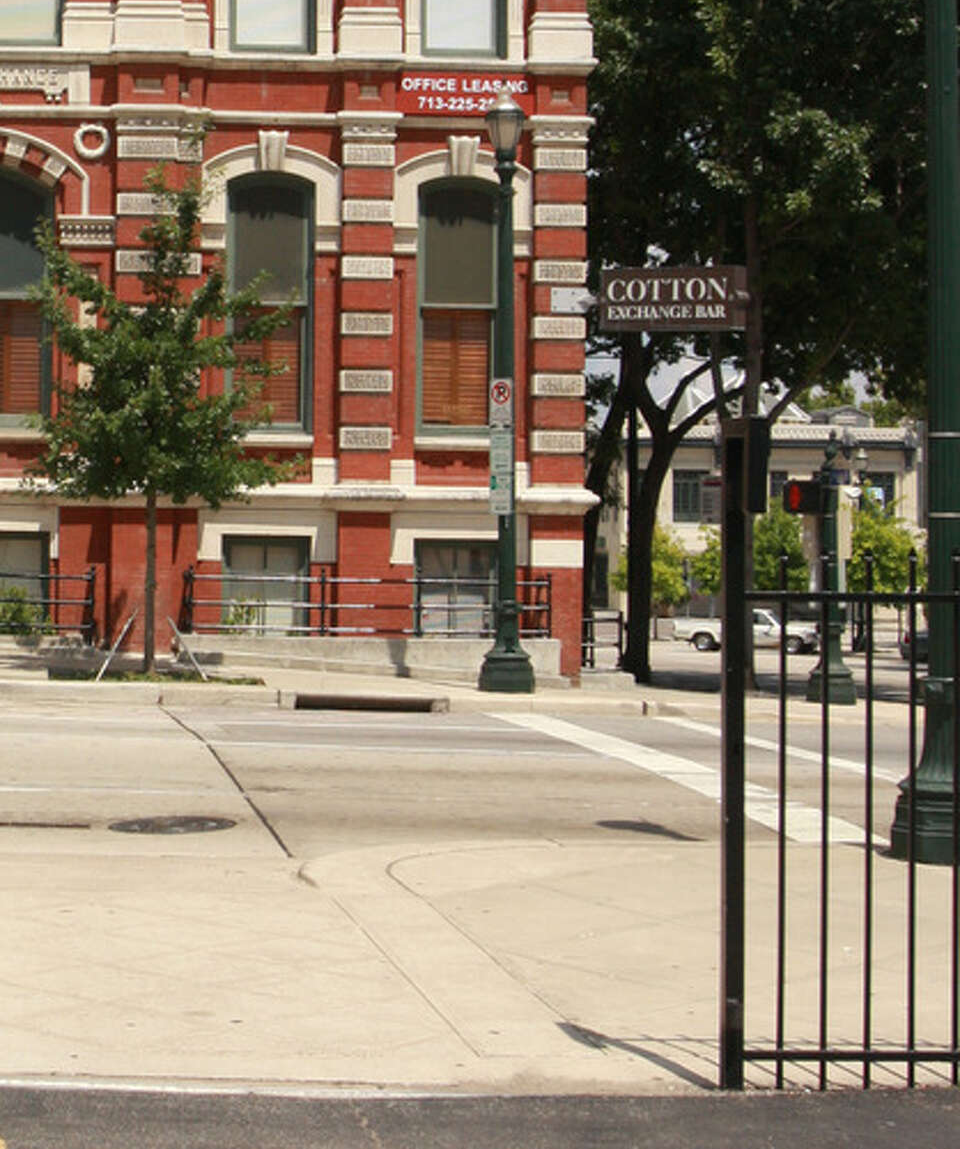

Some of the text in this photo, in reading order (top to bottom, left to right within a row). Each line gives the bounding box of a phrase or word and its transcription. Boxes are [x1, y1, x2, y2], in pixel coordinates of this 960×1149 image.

[401, 78, 528, 93] OFFICE LEASNG
[607, 277, 728, 302] COTTON
[607, 304, 726, 320] EXCHANGE BAR
